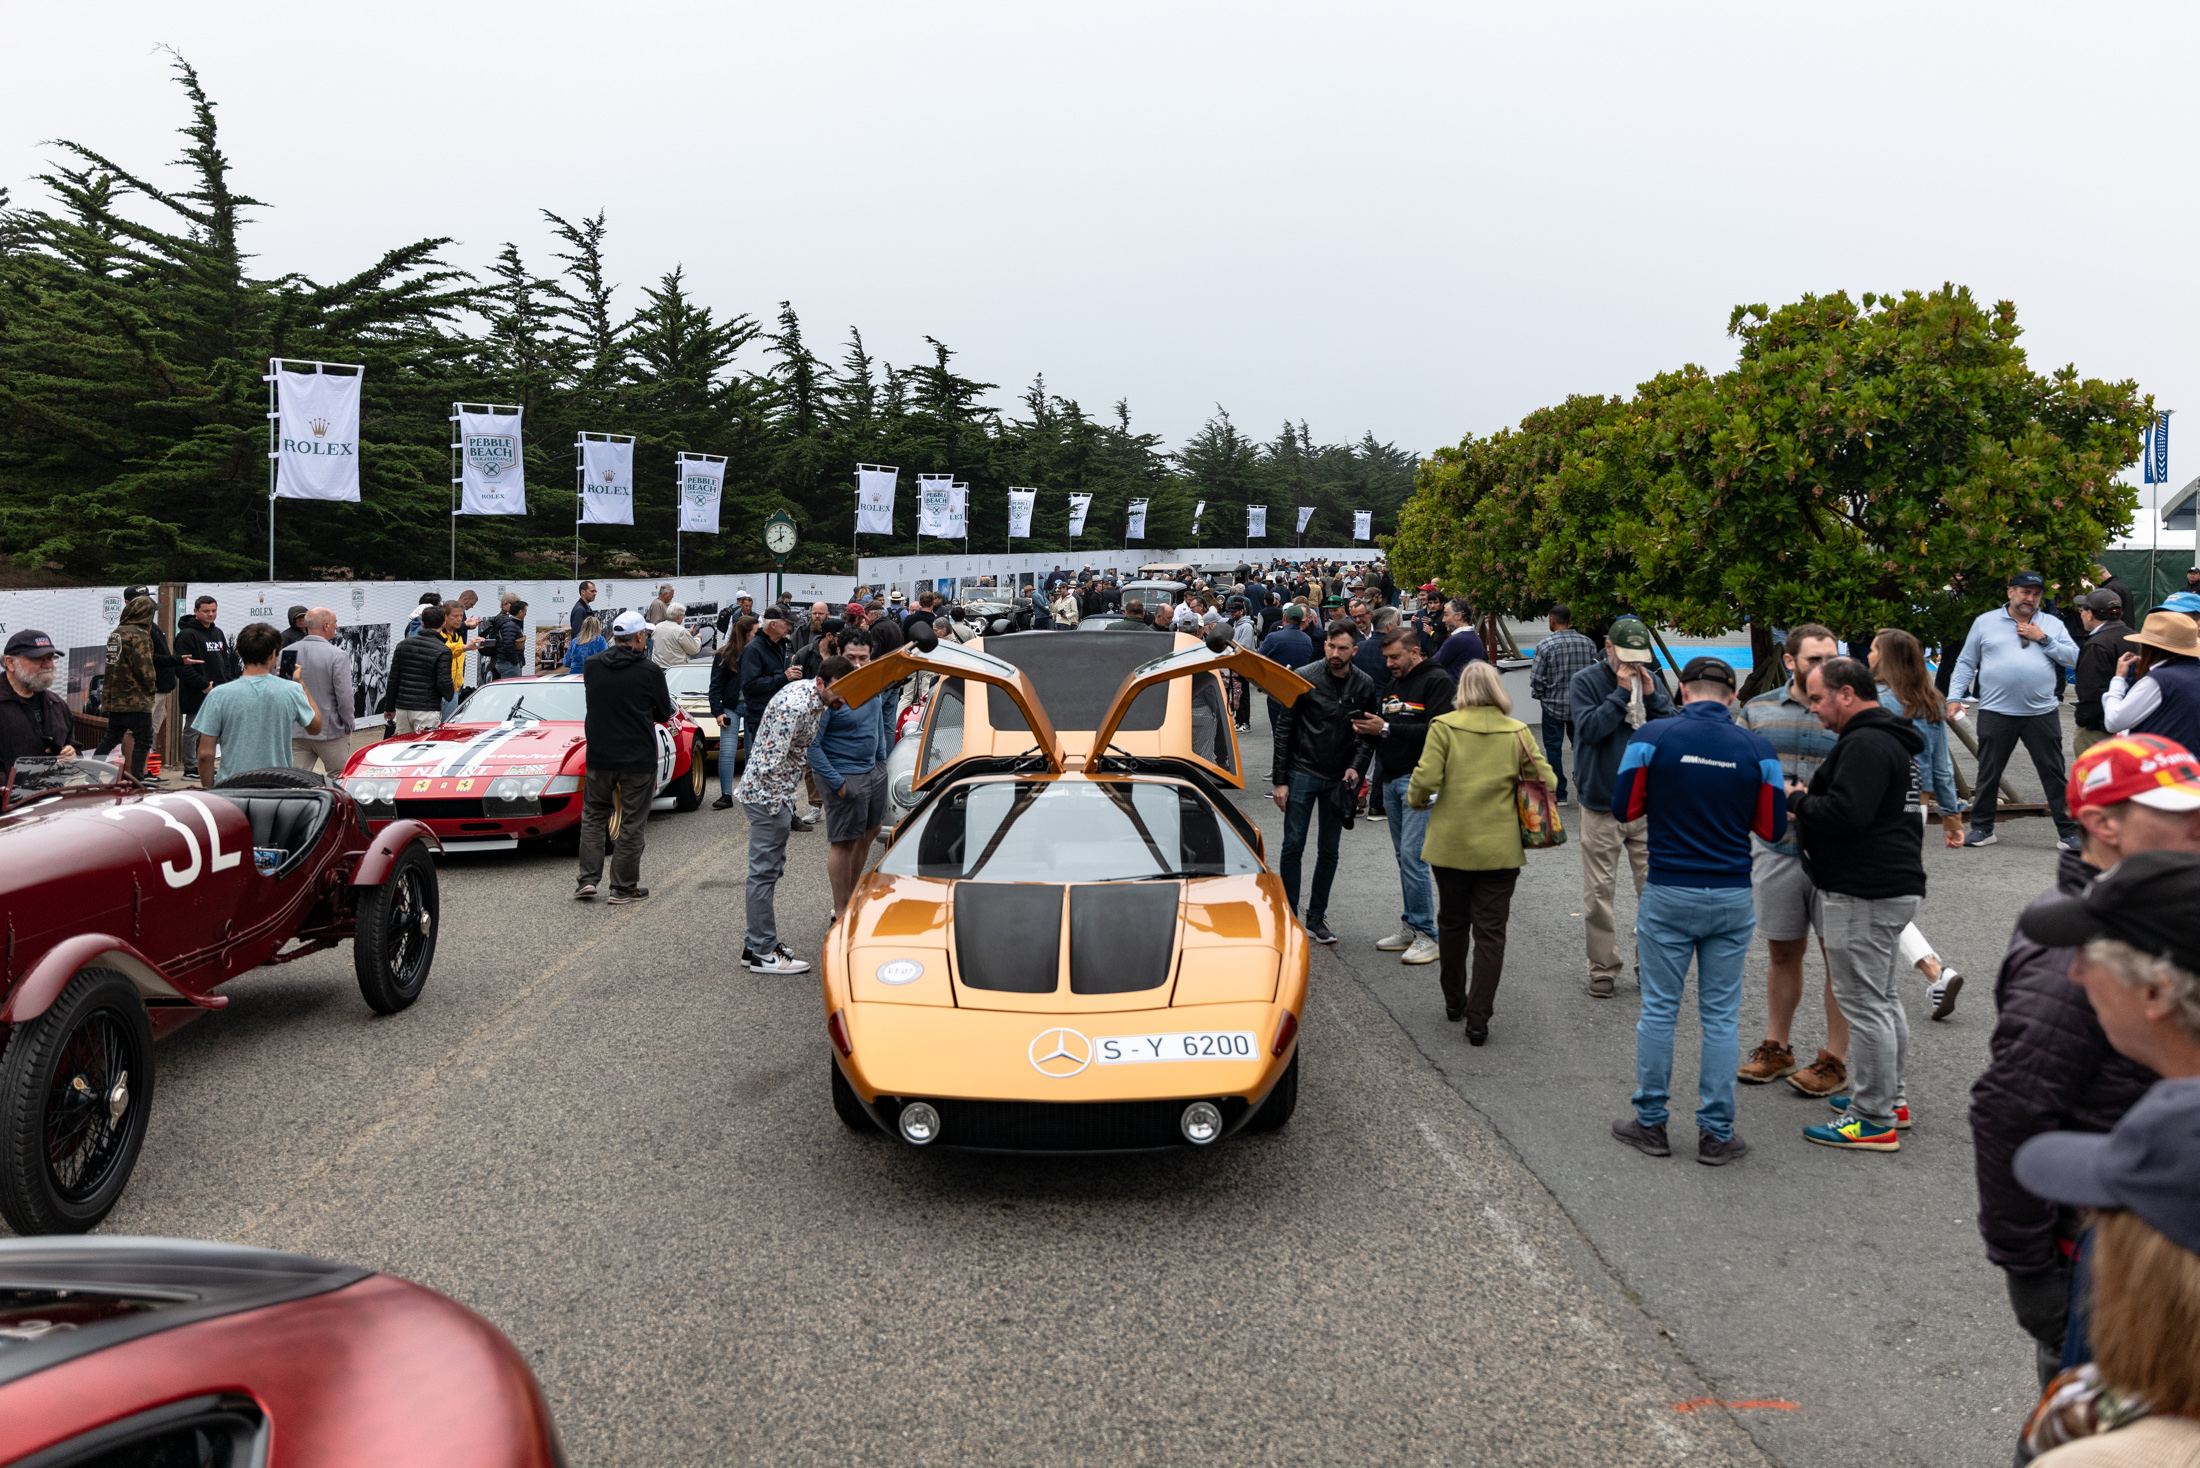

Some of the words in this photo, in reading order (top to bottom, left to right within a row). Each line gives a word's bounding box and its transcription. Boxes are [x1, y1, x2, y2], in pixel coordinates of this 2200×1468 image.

[283, 438, 353, 456] ROLEX
[469, 438, 512, 448] PEBBLE
[470, 447, 512, 458] BEACH
[687, 477, 717, 487] PEBBLE
[587, 483, 630, 496] ROLEX
[687, 484, 717, 493] BEACH
[860, 503, 891, 512] ROLEX
[250, 607, 273, 617] ROLEX
[391, 743, 438, 762] 6
[1699, 757, 1737, 769] Motorsport
[102, 792, 242, 889] 32
[1183, 1035, 1250, 1056] 6200
